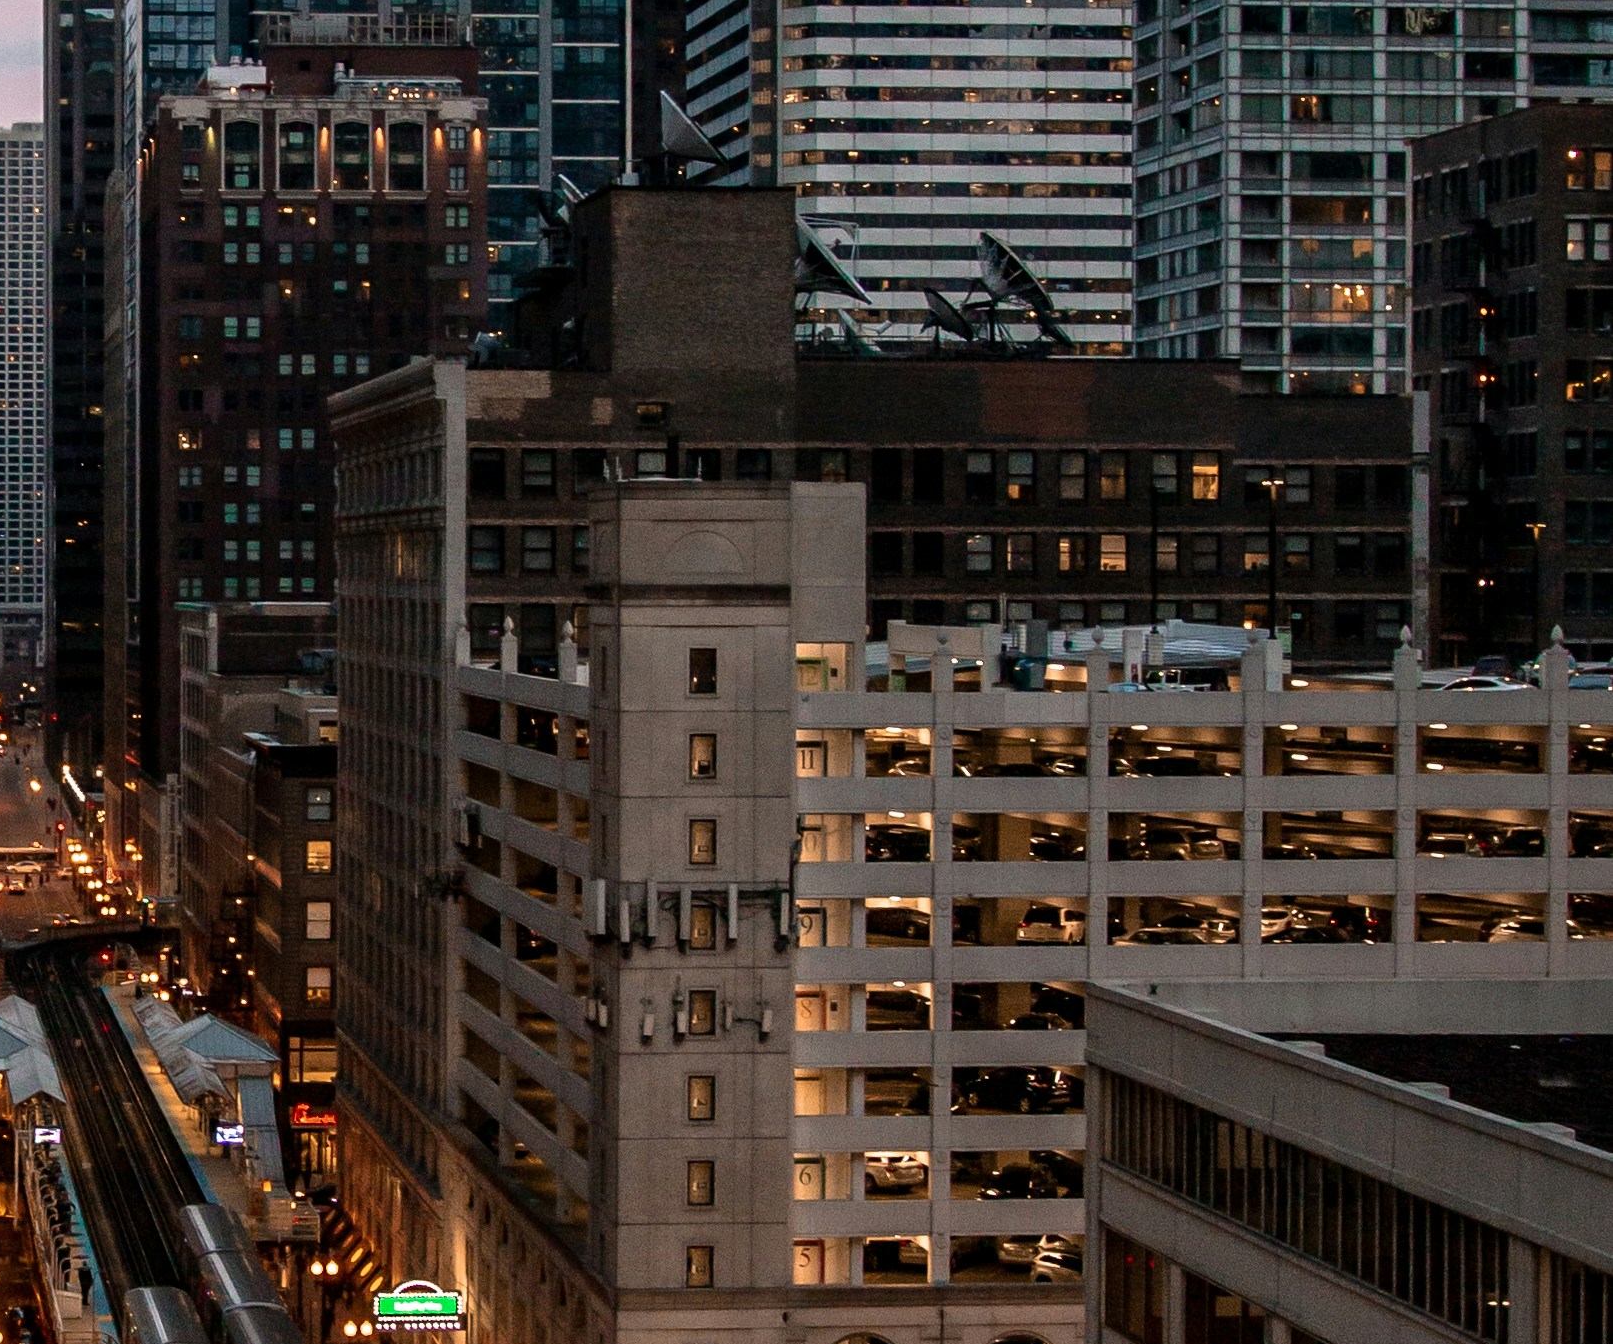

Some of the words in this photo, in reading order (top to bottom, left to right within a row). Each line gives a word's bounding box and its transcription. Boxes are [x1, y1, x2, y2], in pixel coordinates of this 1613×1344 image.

[801, 915, 813, 935] 9
[799, 1165, 812, 1186] 6
[798, 1247, 811, 1268] 5
